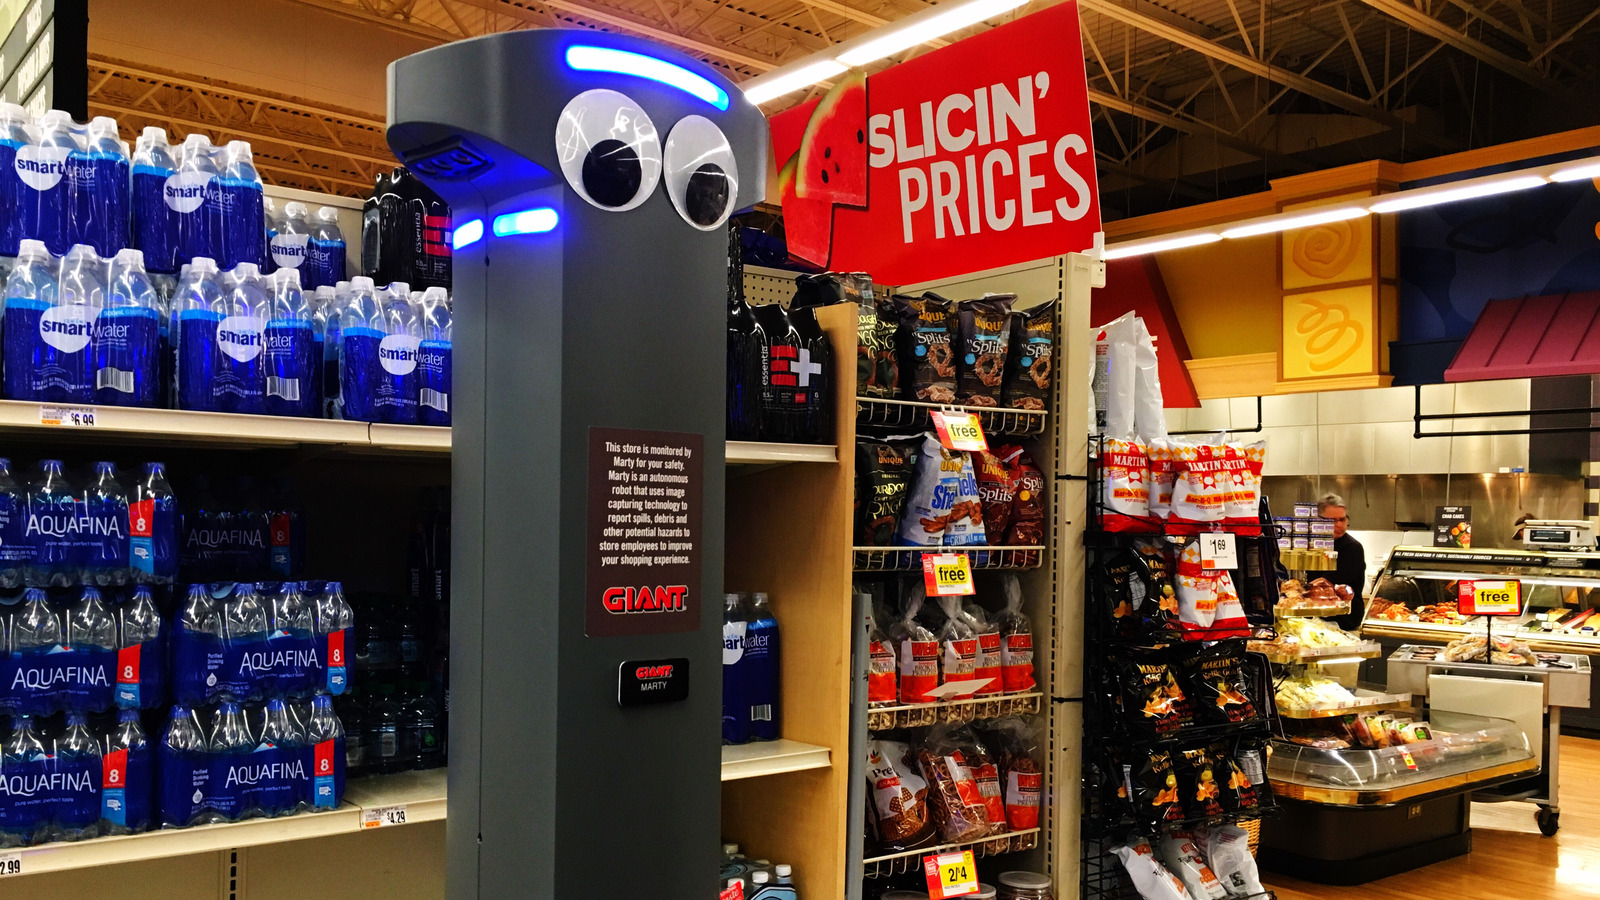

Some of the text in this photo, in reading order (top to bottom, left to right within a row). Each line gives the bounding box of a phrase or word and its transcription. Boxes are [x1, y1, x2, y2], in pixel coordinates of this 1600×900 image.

[868, 71, 1050, 168] SLICIN'
[898, 133, 1092, 244] PRICES
[42, 318, 130, 338] smartwater
[380, 347, 444, 366] smartwater
[950, 423, 978, 438] free
[605, 441, 692, 459] This store is monitored by
[613, 456, 685, 472] Marty for your safety.
[1113, 454, 1148, 467] MARTIN'
[608, 470, 689, 484] Marty is an autonomous
[611, 485, 686, 499] robot that uses image
[608, 498, 688, 512] capturing technology to
[25, 513, 146, 538] AQUAFINA 8
[607, 513, 688, 525] report spills, debris and
[187, 528, 264, 548] AQUAFINA
[603, 526, 691, 539] other potential hazards to
[599, 540, 693, 553] store employees to improve
[601, 554, 691, 567] your shopping experience.
[938, 566, 966, 581] free
[602, 585, 689, 615] GIANT
[1480, 591, 1510, 602] free
[722, 633, 770, 651] artwater
[239, 647, 341, 675] AQUAFINA 8
[11, 664, 134, 691] AQUAFINA 8
[635, 665, 673, 680] GIANT
[640, 681, 668, 692] MARTY
[225, 758, 329, 789] AQUAFINA 8
[0, 769, 119, 797] AQUAFINA 8
[387, 810, 406, 824] $4.29
